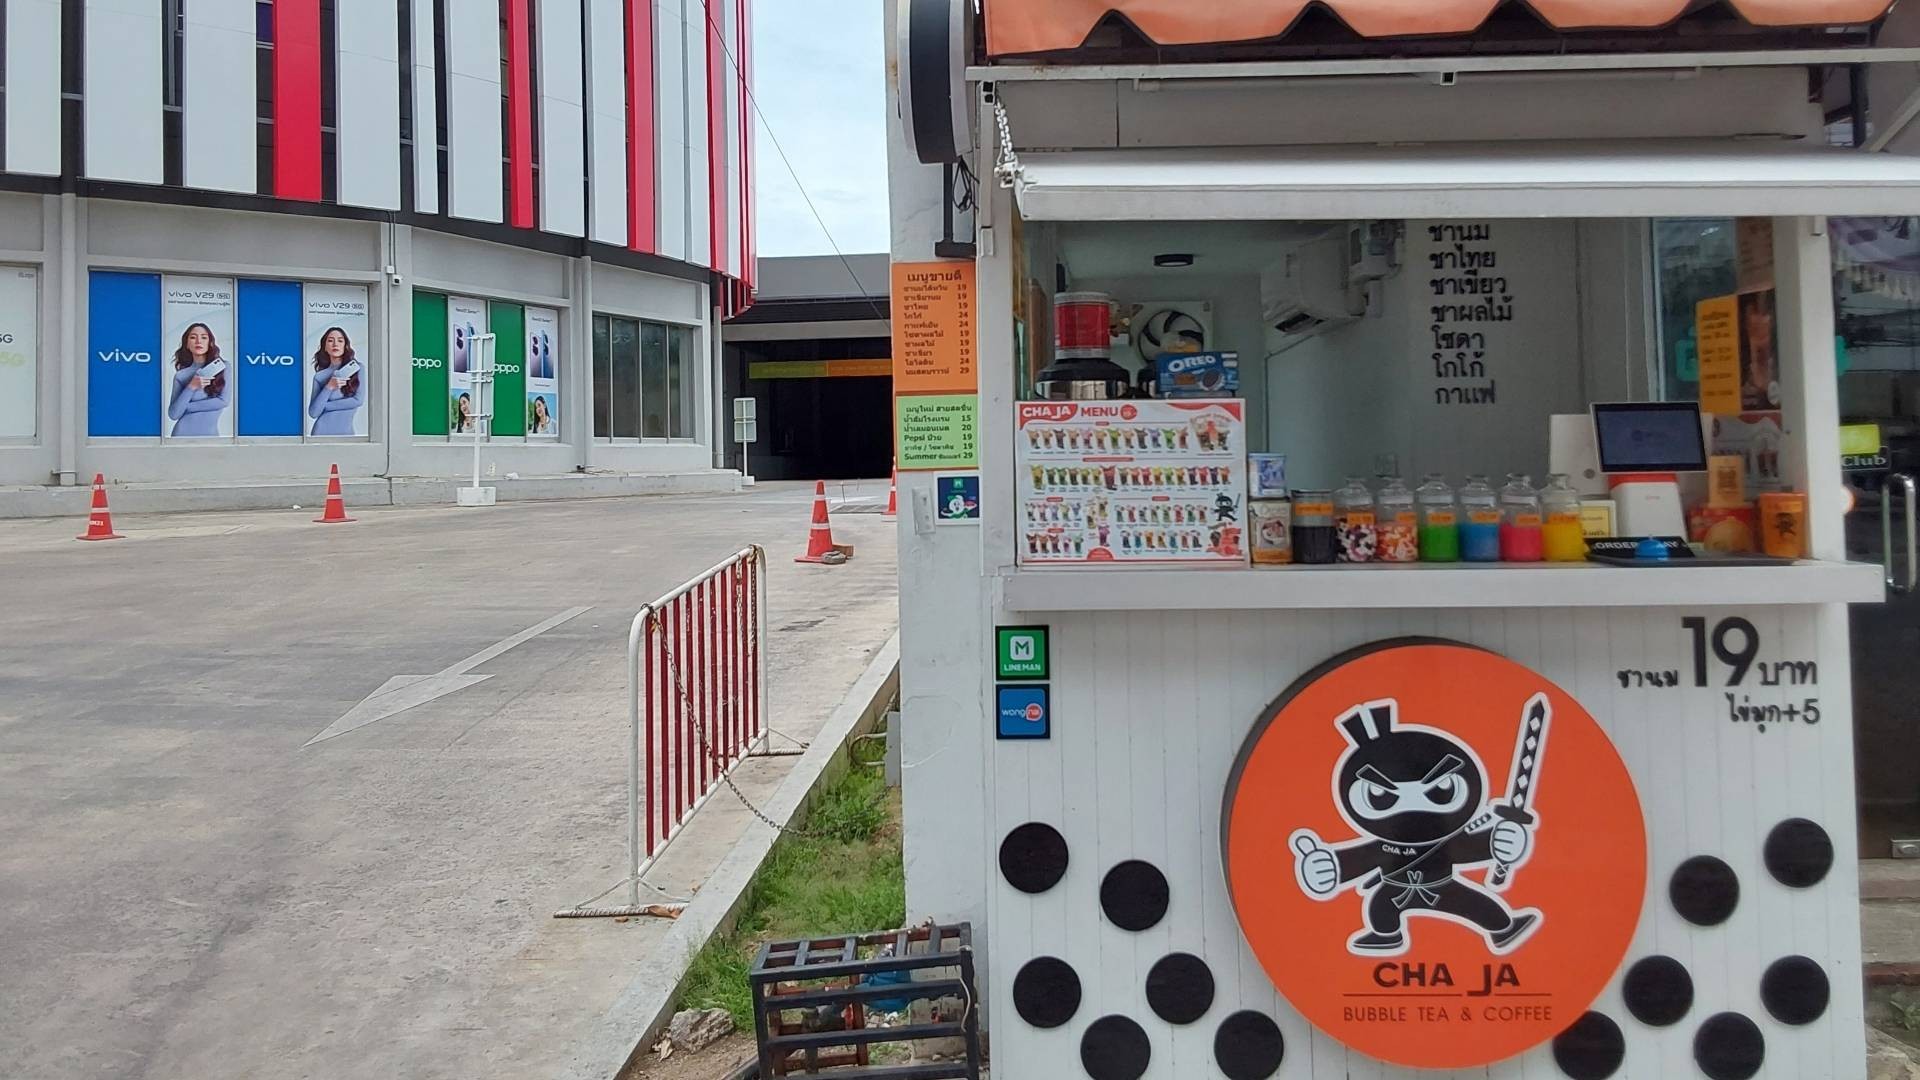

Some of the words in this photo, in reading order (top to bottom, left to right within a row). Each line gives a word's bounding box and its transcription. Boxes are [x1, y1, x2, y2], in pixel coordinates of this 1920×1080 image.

[1428, 223, 1490, 242] ชานม
[1429, 243, 1496, 270] ชาไทย
[907, 269, 962, 283] เมนูขายดี
[1430, 269, 1507, 295] ชาเขียว
[1430, 295, 1514, 323] ชาผลไม้
[98, 348, 152, 364] vivo
[246, 353, 295, 367] vivo
[412, 357, 442, 369] oppo
[1168, 355, 1217, 372] OREO
[1432, 352, 1485, 378] โกโก้
[1435, 380, 1496, 405] กาแฟ
[1022, 406, 1052, 417] CHA
[1051, 405, 1071, 419] JA
[1081, 406, 1119, 417] MENU
[904, 434, 925, 442] Pepsi
[1616, 669, 1679, 689] ชานม
[1681, 616, 1760, 688] 19
[1758, 660, 1818, 686] บาท
[1381, 843, 1401, 855] CHA
[1401, 846, 1417, 856] JA
[1372, 961, 1455, 988] CHA
[1467, 962, 1521, 997] JA
[1343, 1006, 1407, 1022] BUBBLE
[1418, 1006, 1449, 1022] TEA
[1460, 1006, 1473, 1022] &
[1483, 1006, 1553, 1022] COFFEE
